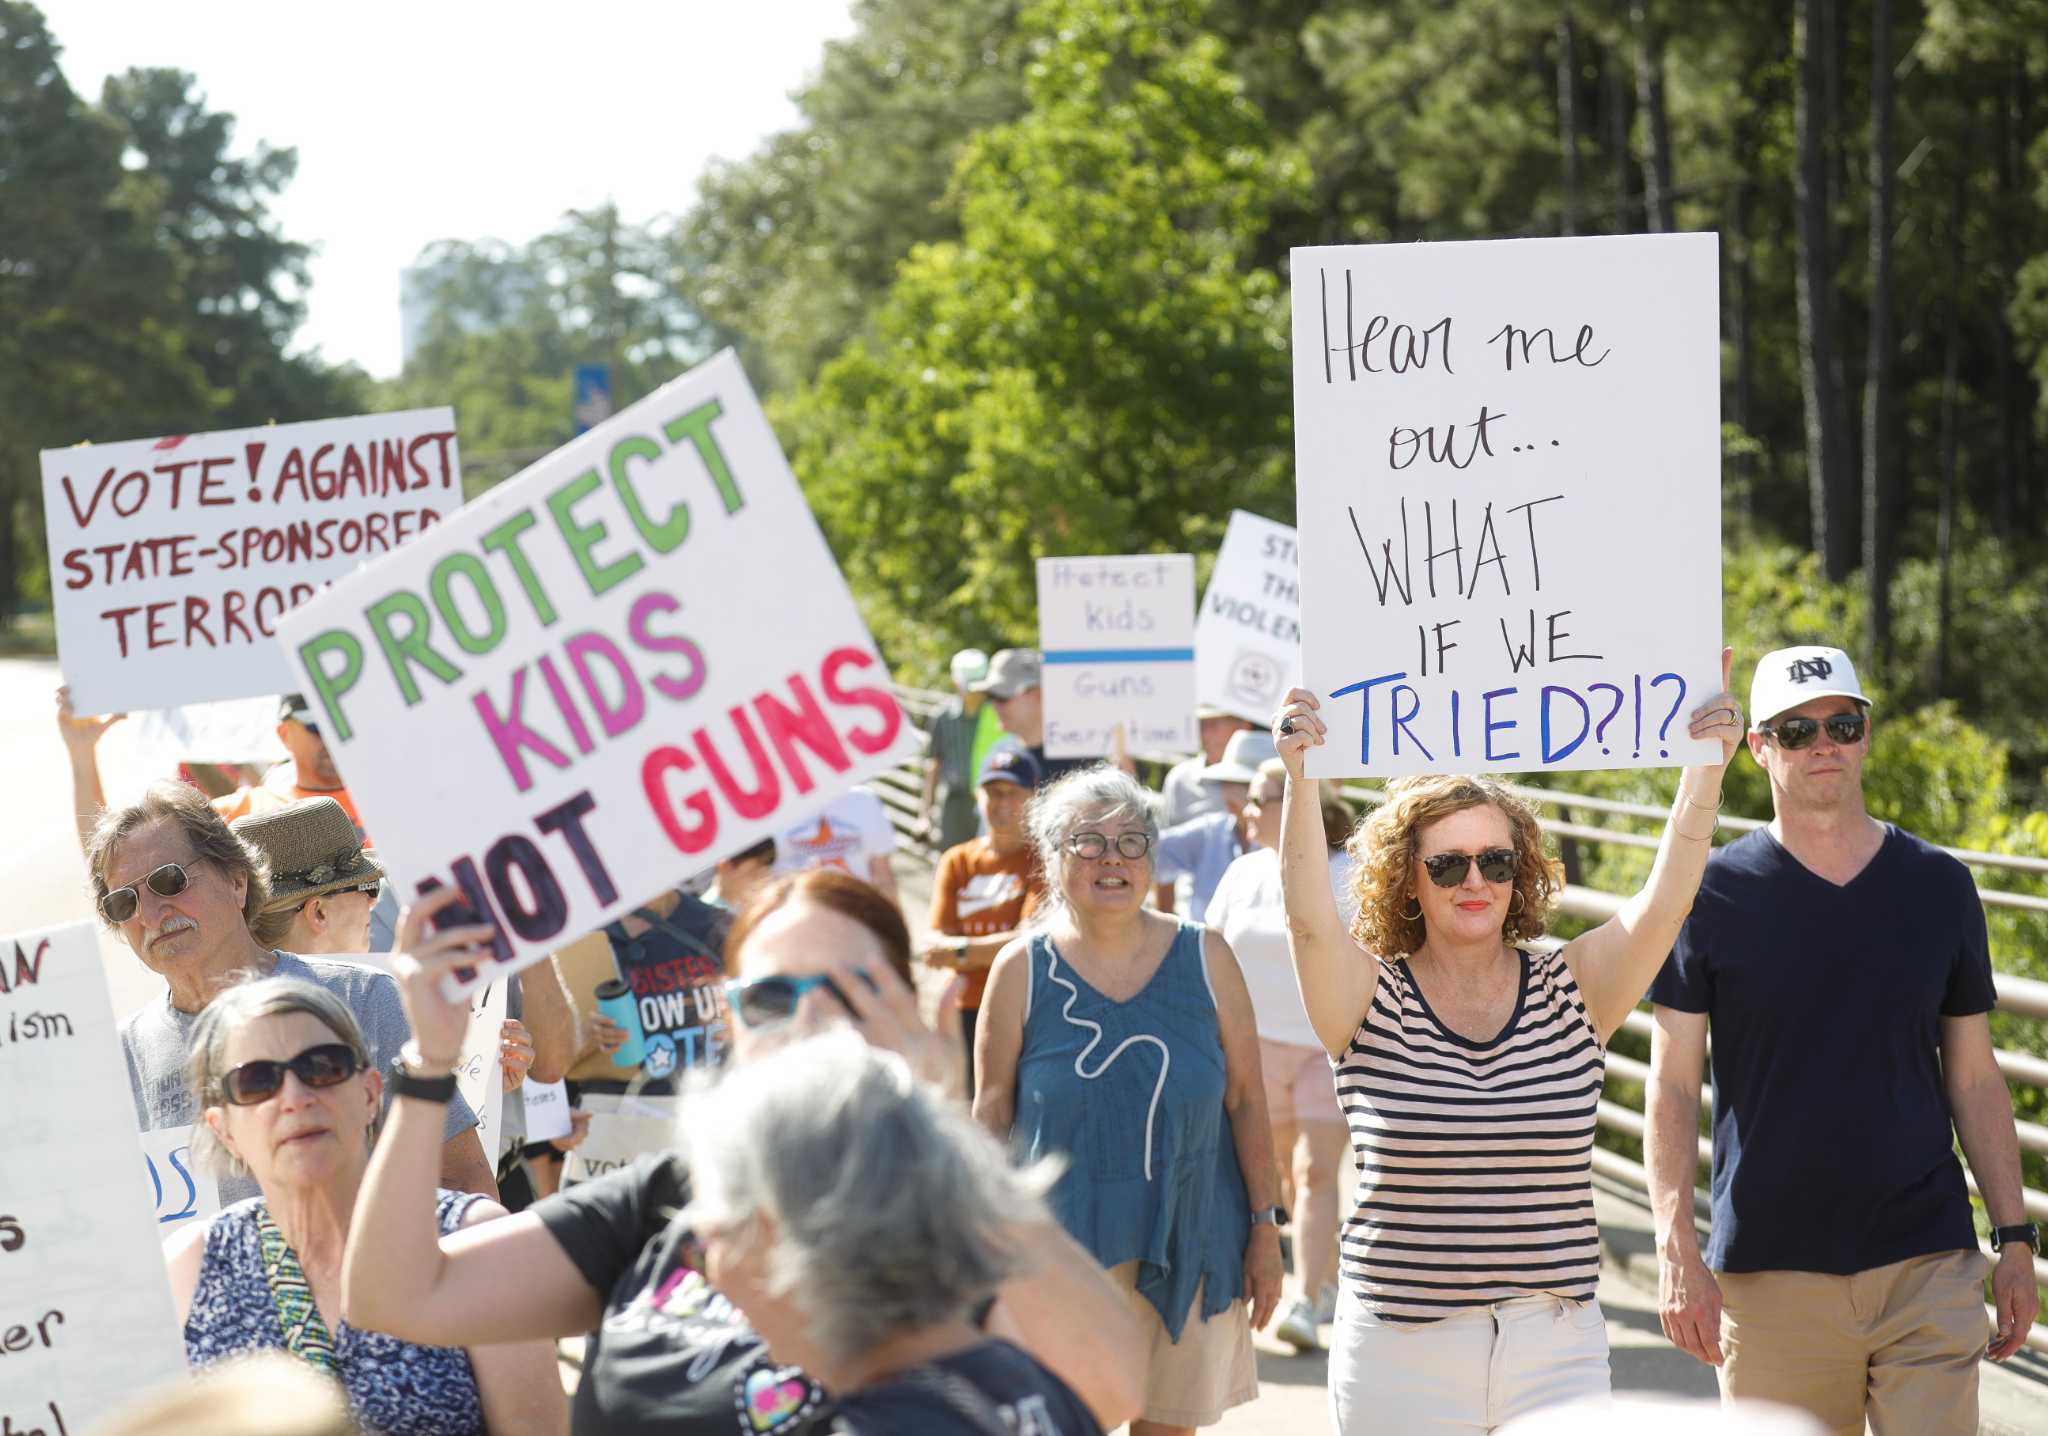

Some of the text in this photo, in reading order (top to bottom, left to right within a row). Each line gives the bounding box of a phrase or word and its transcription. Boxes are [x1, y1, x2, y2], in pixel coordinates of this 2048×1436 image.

[1320, 267, 1611, 384] Hear me
[1388, 406, 1560, 469] out...
[61, 431, 457, 529] VOTE! AGAINST
[299, 396, 746, 742] PROTECT
[1263, 533, 1299, 567] ST
[1348, 495, 1565, 606] WHAT
[100, 579, 334, 659] TERRO
[1212, 591, 1300, 644] VIOLEN
[1263, 571, 1299, 608] TH
[1418, 608, 1604, 677] IF WE
[472, 591, 709, 793] KIDS
[1329, 671, 1688, 765] TRIED?!?
[639, 645, 902, 856] GUNS
[0, 1011, 74, 1046] ism
[640, 990, 686, 1032] OW
[644, 1023, 728, 1079] OTE
